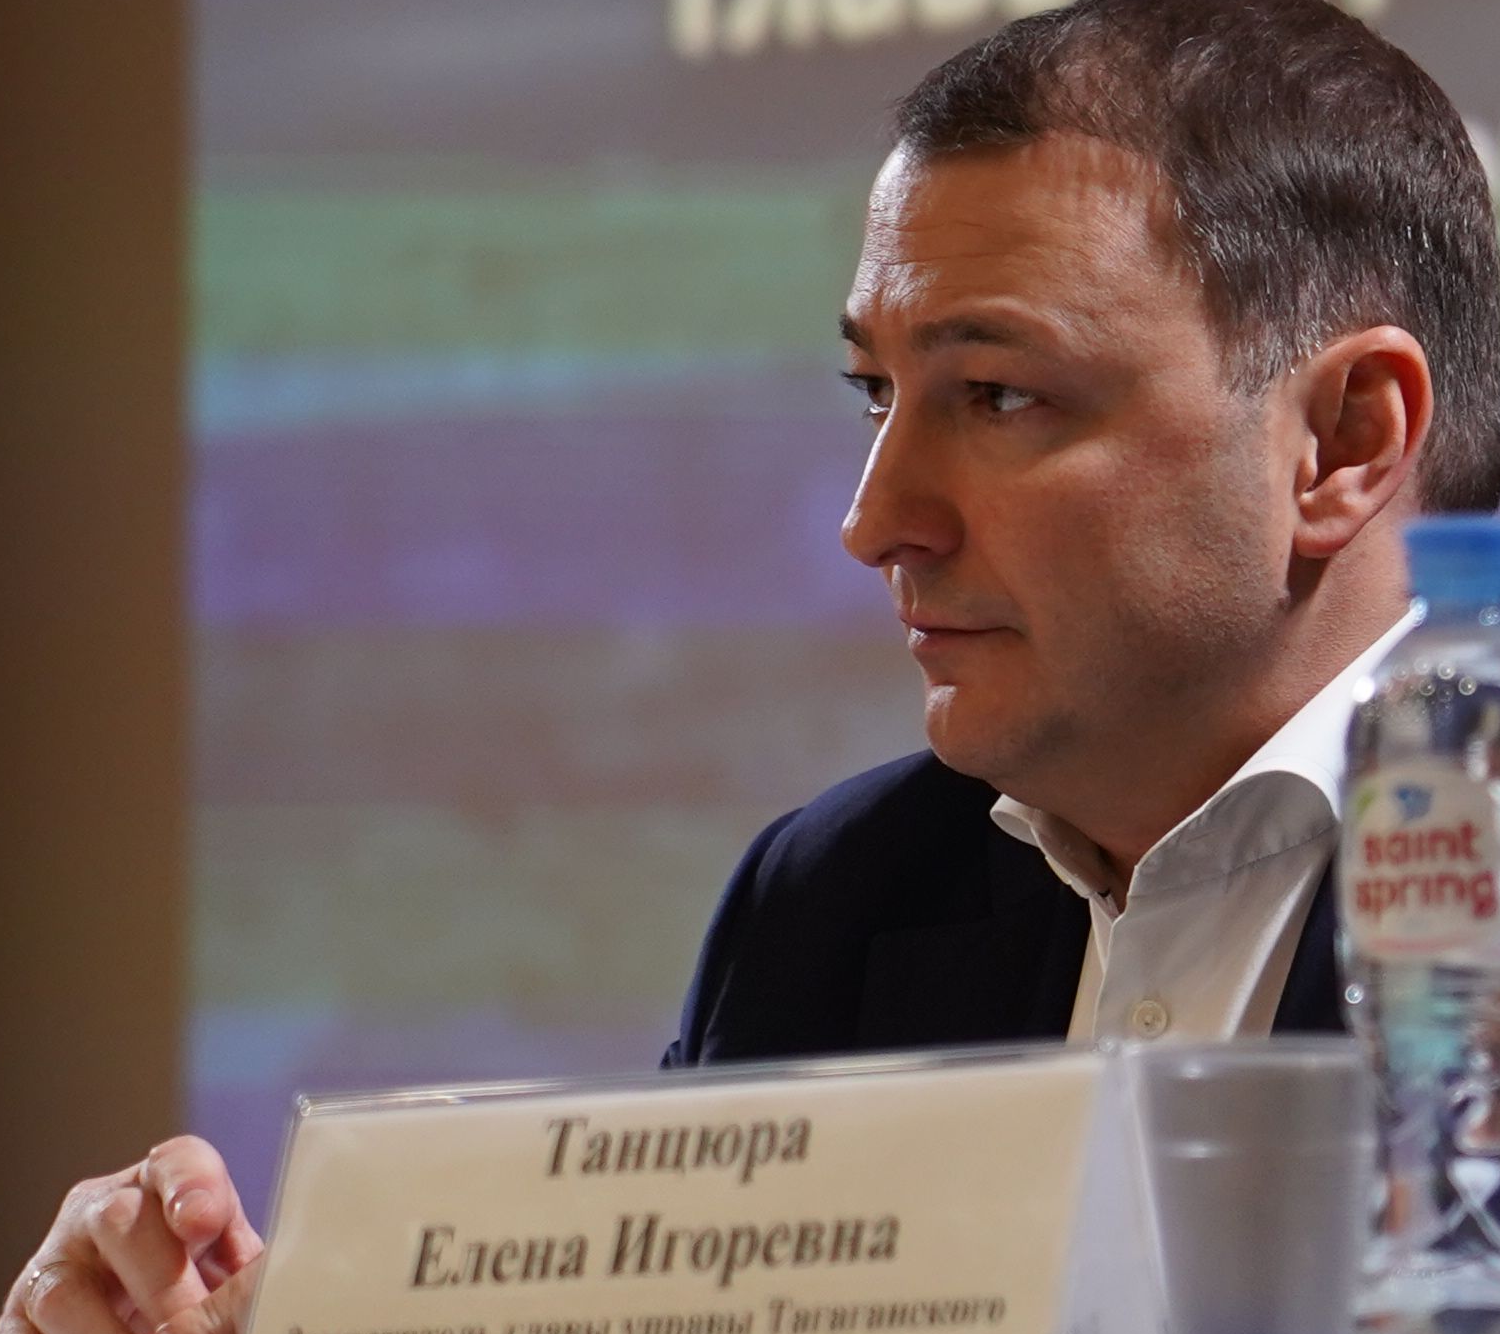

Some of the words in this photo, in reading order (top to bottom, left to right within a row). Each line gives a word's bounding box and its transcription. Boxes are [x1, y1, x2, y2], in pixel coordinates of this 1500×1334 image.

[1364, 821, 1482, 866] saint
[1356, 870, 1496, 923] spring
[545, 1115, 812, 1185] Танцюра
[410, 1223, 589, 1290] Елена
[608, 1210, 901, 1289] Игоревна
